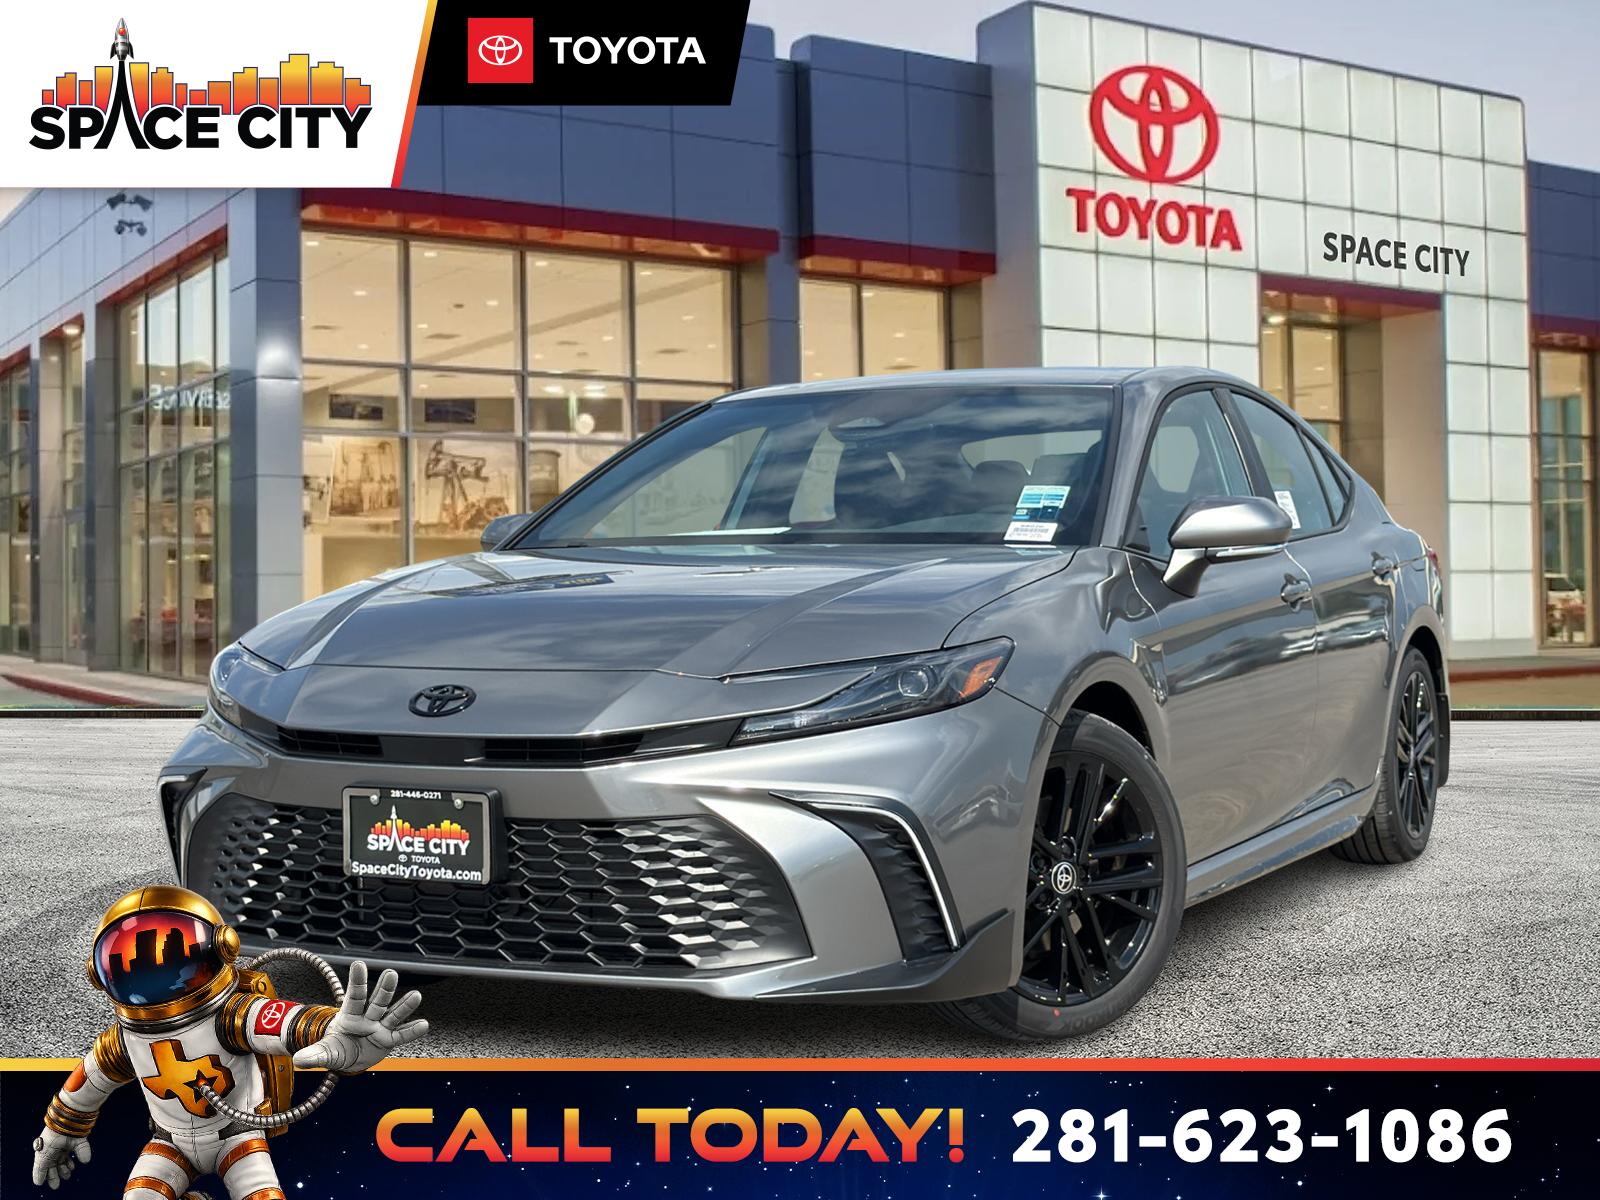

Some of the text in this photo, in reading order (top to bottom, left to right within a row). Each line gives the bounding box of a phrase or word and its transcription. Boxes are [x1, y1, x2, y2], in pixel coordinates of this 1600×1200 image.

[1066, 187, 1243, 252] TOYOTA
[1322, 231, 1471, 278] SPACE CITY
[390, 789, 442, 800] 281-446-0271
[366, 829, 471, 856] SPACE CITY
[351, 860, 482, 882] SpaceCityToyota.com
[411, 855, 441, 865] TOYOTA
